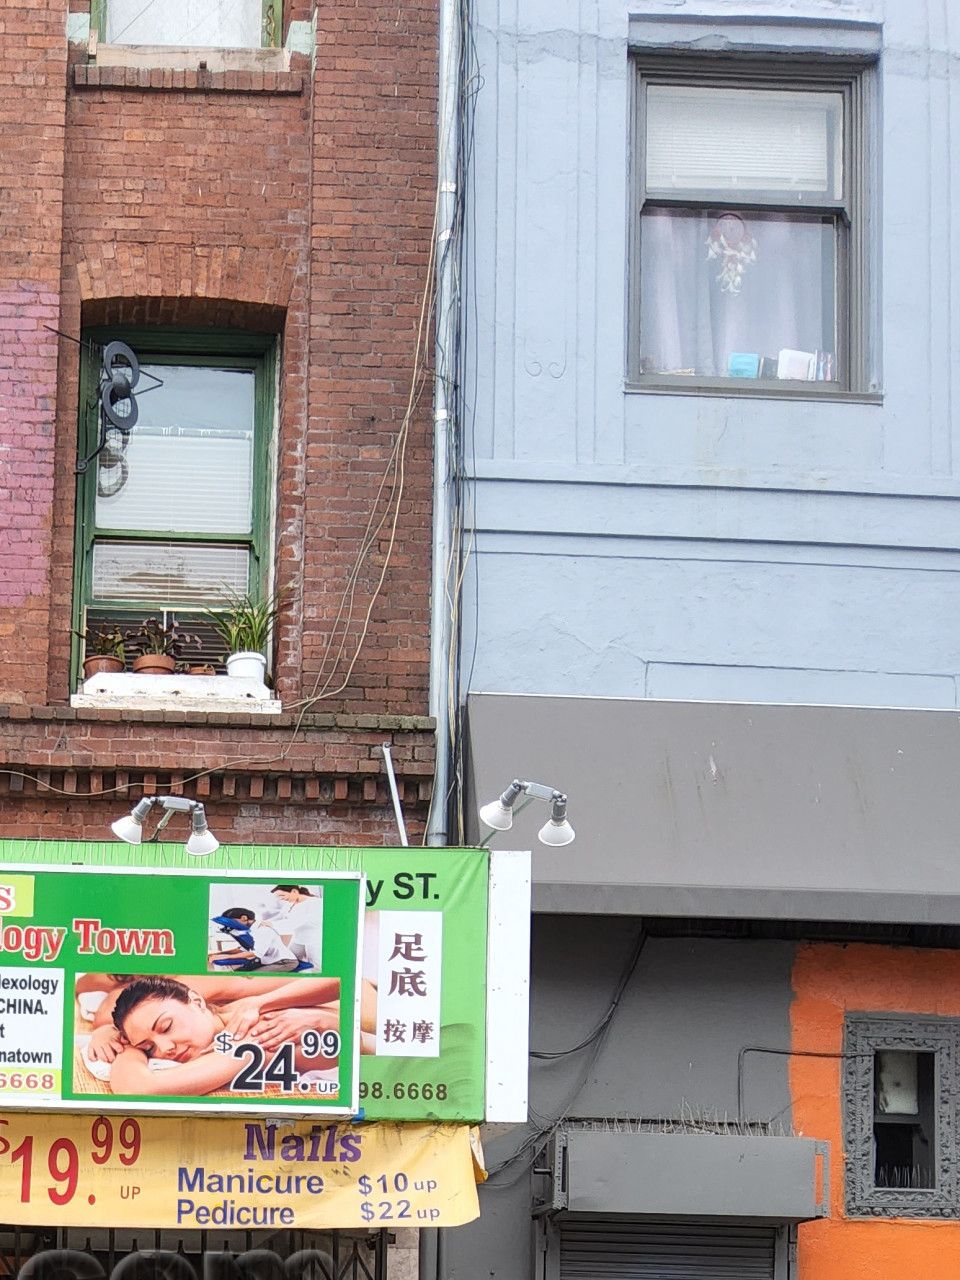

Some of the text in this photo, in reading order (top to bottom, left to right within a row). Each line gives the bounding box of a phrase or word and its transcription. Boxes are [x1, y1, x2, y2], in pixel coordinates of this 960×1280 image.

[393, 872, 440, 900] ST.
[73, 919, 176, 955] Town
[388, 932, 428, 997] 足底
[318, 1081, 340, 1093] UP
[243, 1123, 362, 1162] Nails
[121, 1186, 141, 1200] UP
[178, 1167, 438, 1195] Manicure $10 up
[177, 1198, 440, 1225] Pedicure $22 up
